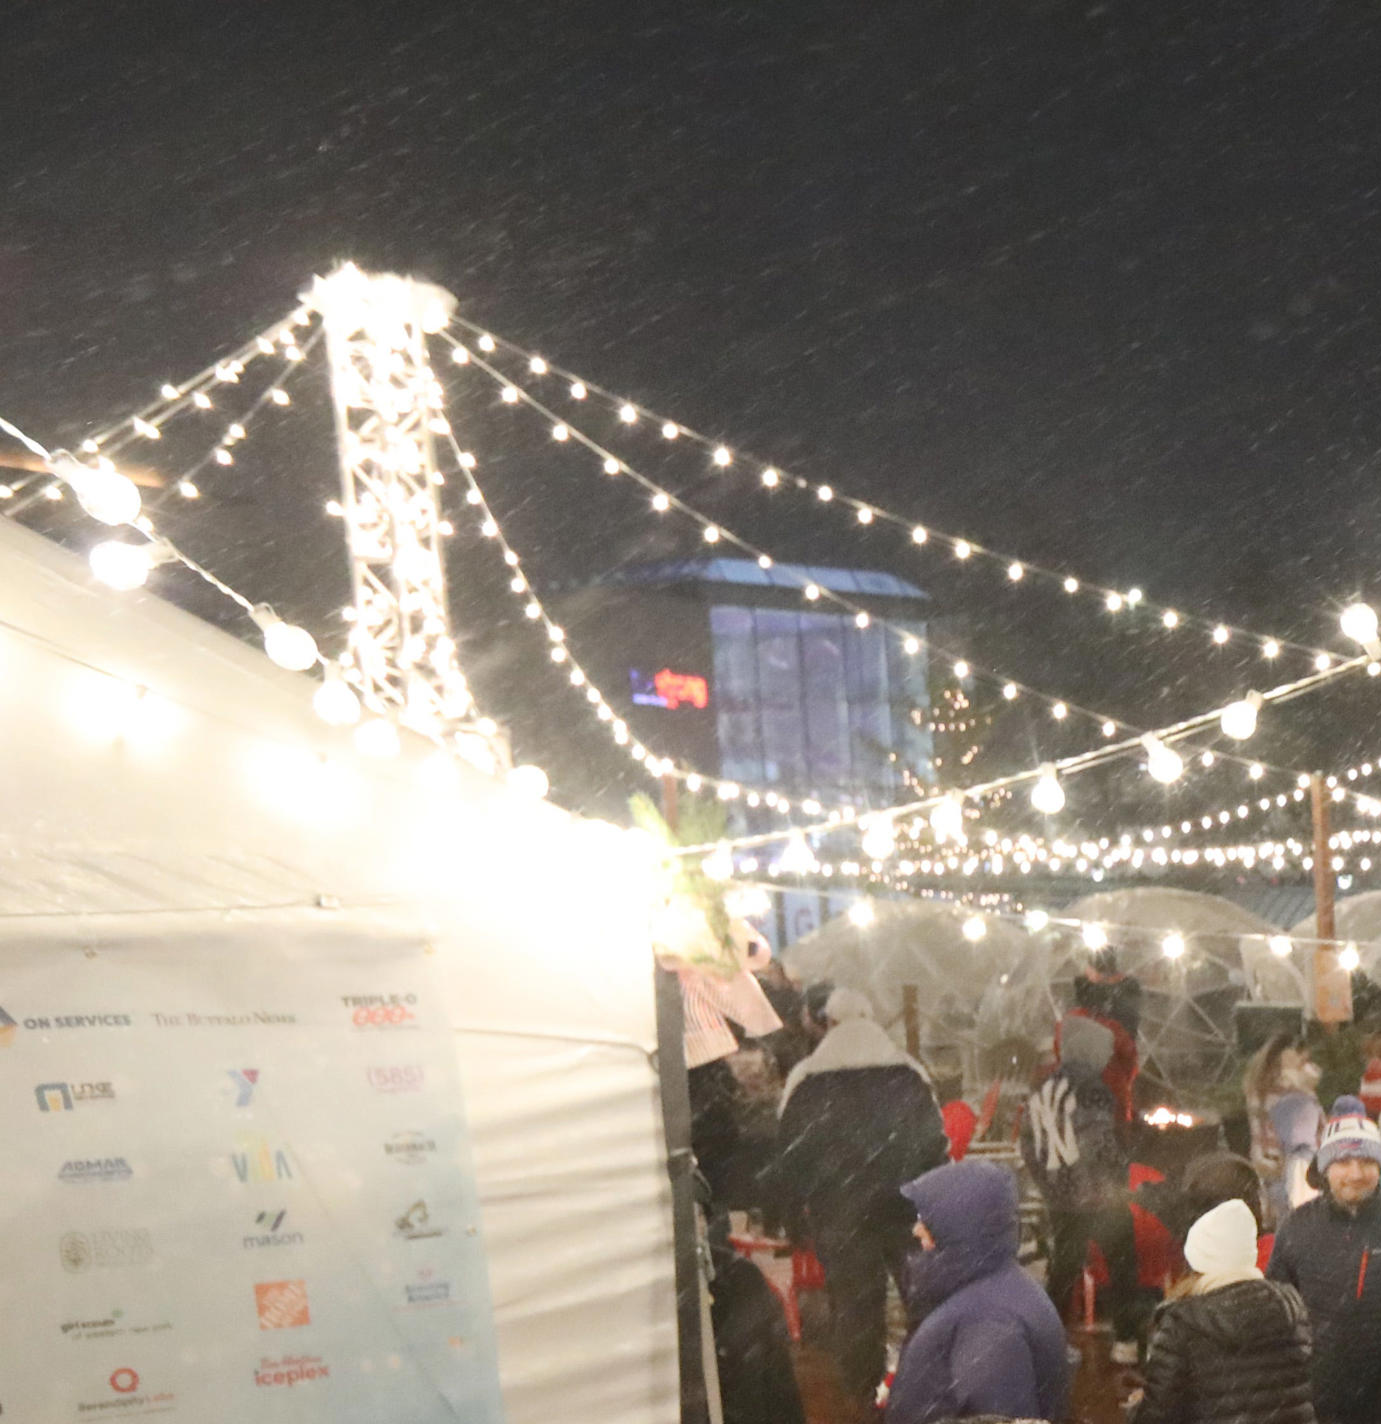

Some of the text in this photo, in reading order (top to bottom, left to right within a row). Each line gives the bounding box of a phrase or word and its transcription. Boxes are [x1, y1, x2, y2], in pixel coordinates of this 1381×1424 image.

[24, 1014, 132, 1030] ON SERVICES
[243, 1231, 304, 1249] mason
